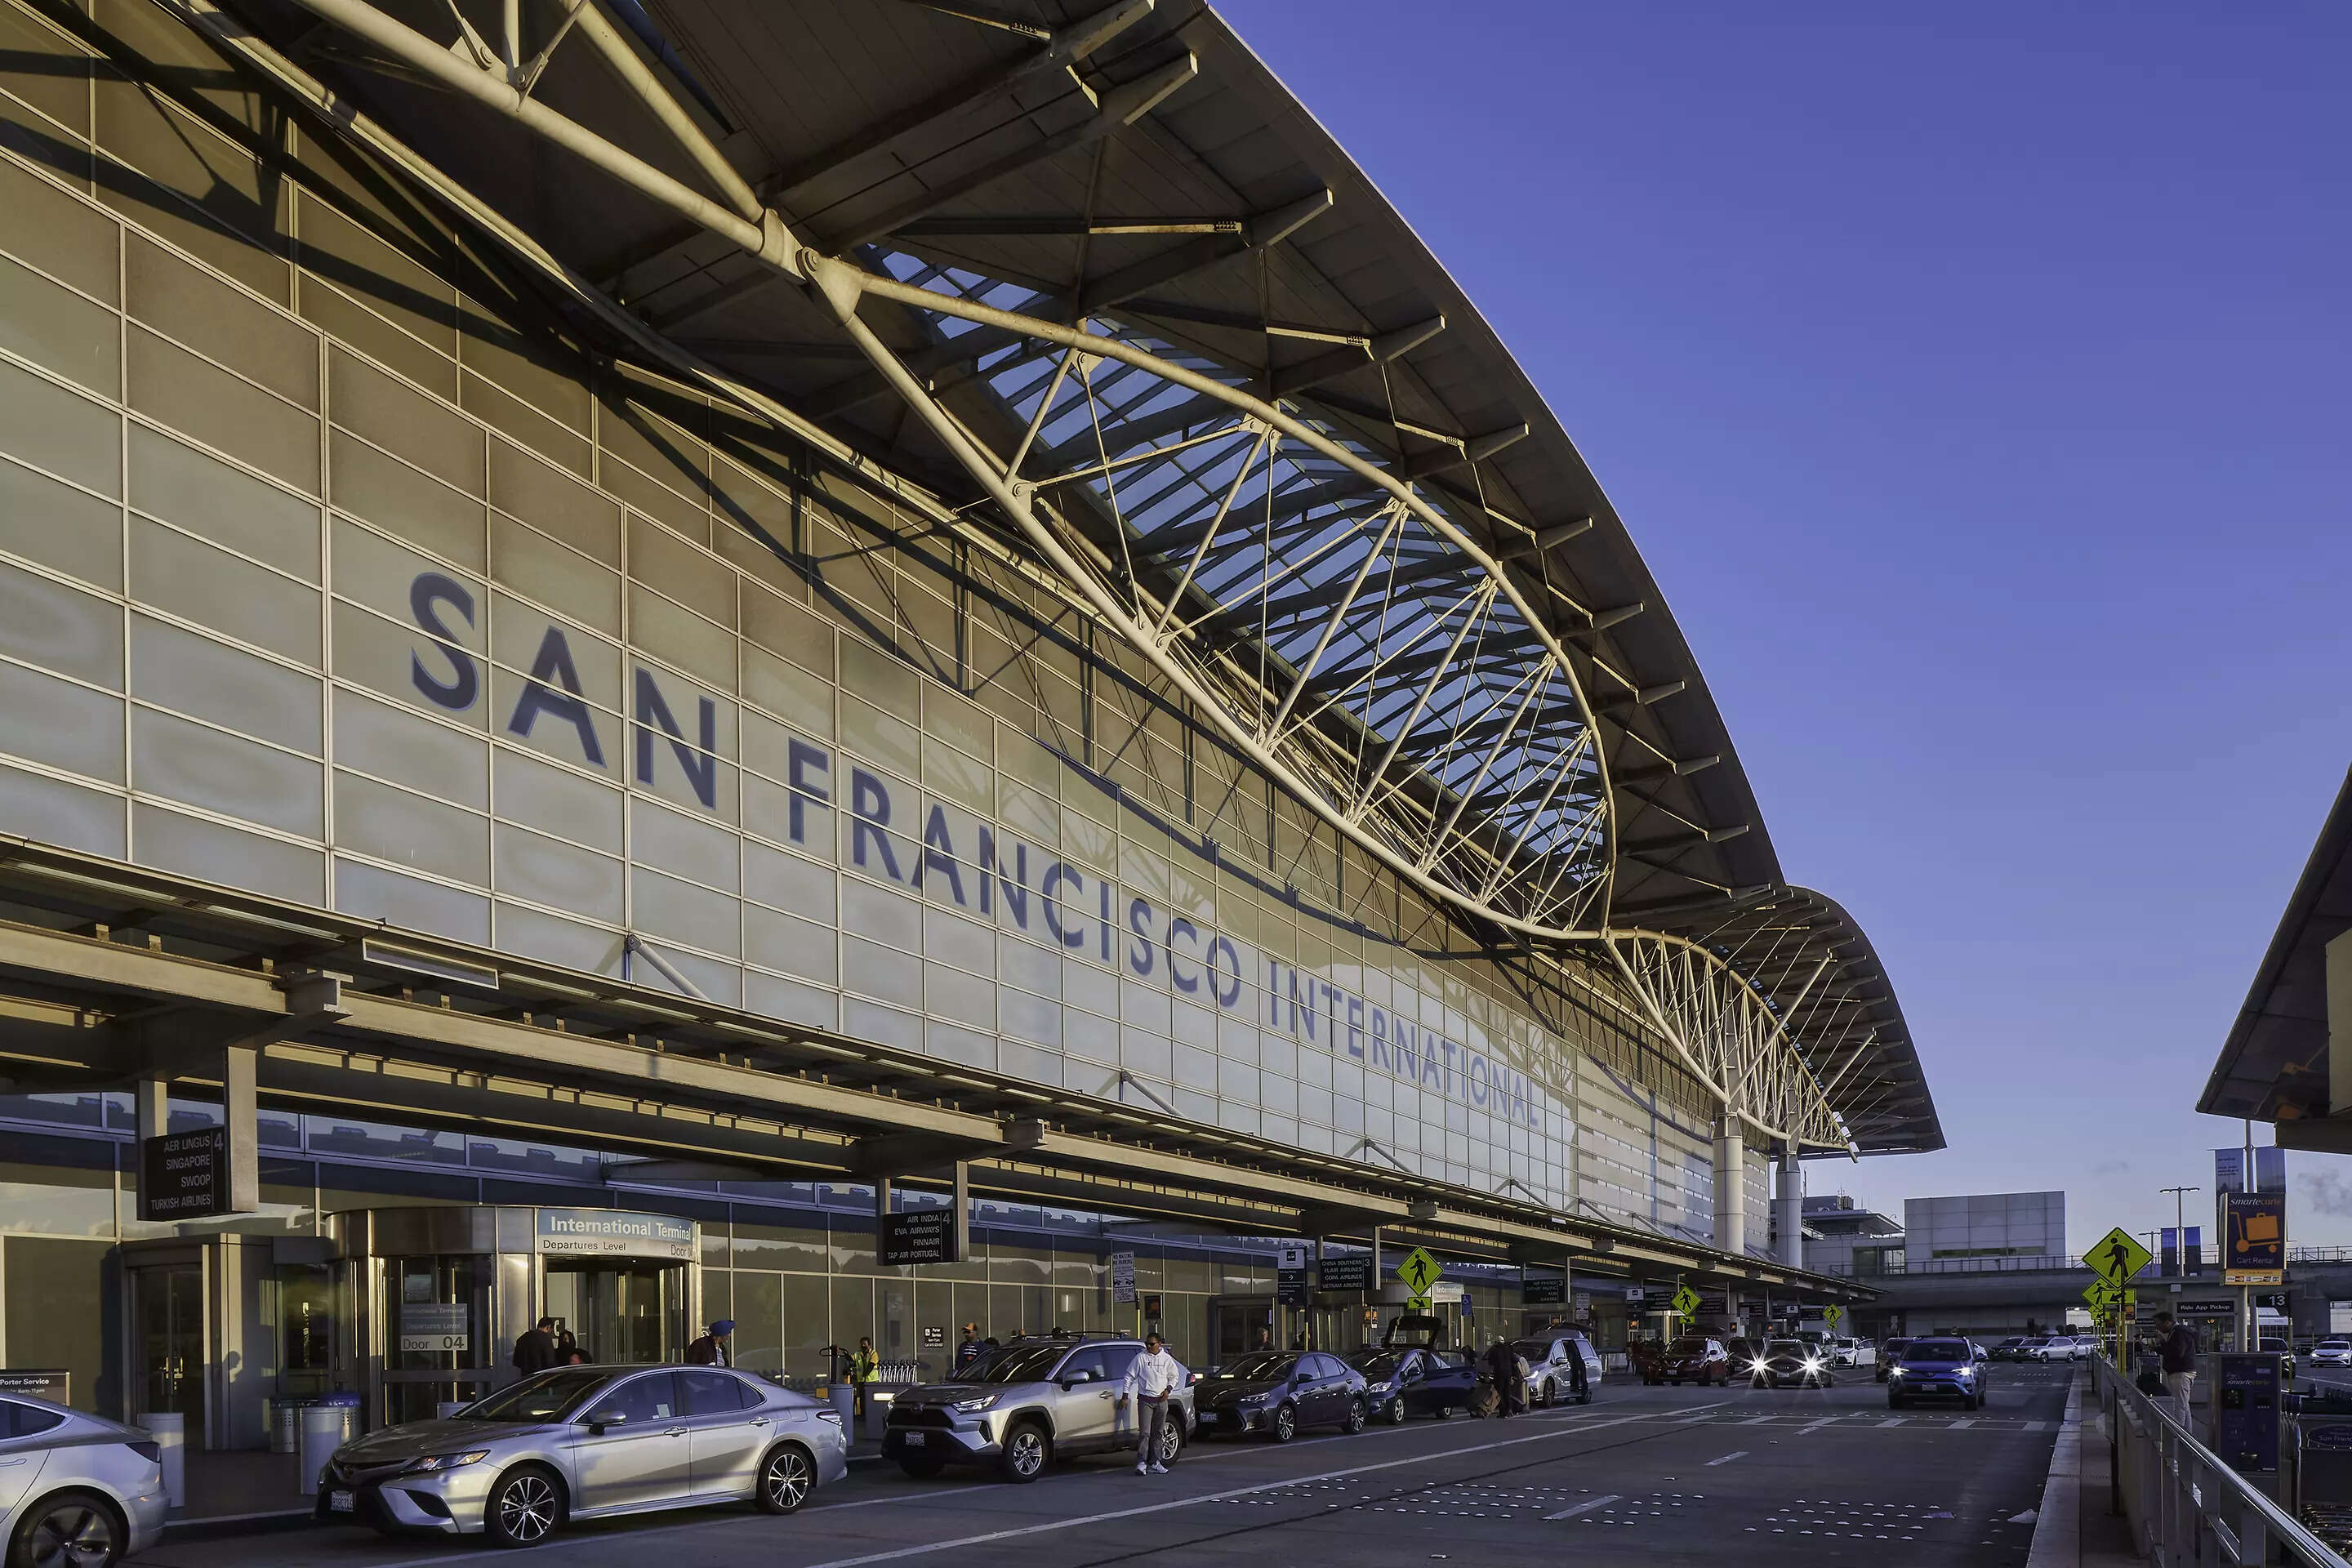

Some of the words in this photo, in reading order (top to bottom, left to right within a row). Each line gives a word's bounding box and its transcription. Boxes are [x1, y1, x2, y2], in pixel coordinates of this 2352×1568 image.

[410, 572, 716, 811] SAN
[788, 737, 1241, 1009] FRANCISCO
[1270, 960, 1540, 1128] INTERNATIONAL
[164, 1139, 180, 1152] AER
[182, 1135, 211, 1150] LINGUS
[214, 1132, 224, 1151] 4
[166, 1154, 211, 1170] SINGAPORE
[180, 1174, 211, 1188] SWOOP
[150, 1197, 180, 1210] TURKISH
[181, 1194, 211, 1207] AIRLINES
[906, 1215, 919, 1223] AIR
[920, 1214, 939, 1223] INDIA
[942, 1212, 951, 1224] 4
[550, 1215, 651, 1236] International
[656, 1222, 691, 1241] Terminal
[894, 1227, 908, 1236] EVA
[909, 1226, 940, 1235] AIRWAYS
[543, 1240, 598, 1251] Departures
[603, 1241, 626, 1251] Level
[913, 1238, 940, 1246] FINNAIR
[670, 1244, 687, 1257] Door
[910, 1250, 940, 1258] PORTUGAL
[1365, 1258, 1370, 1267] 3
[2269, 1295, 2286, 1306] 13
[403, 1339, 430, 1349] Door
[443, 1336, 465, 1349] 04
